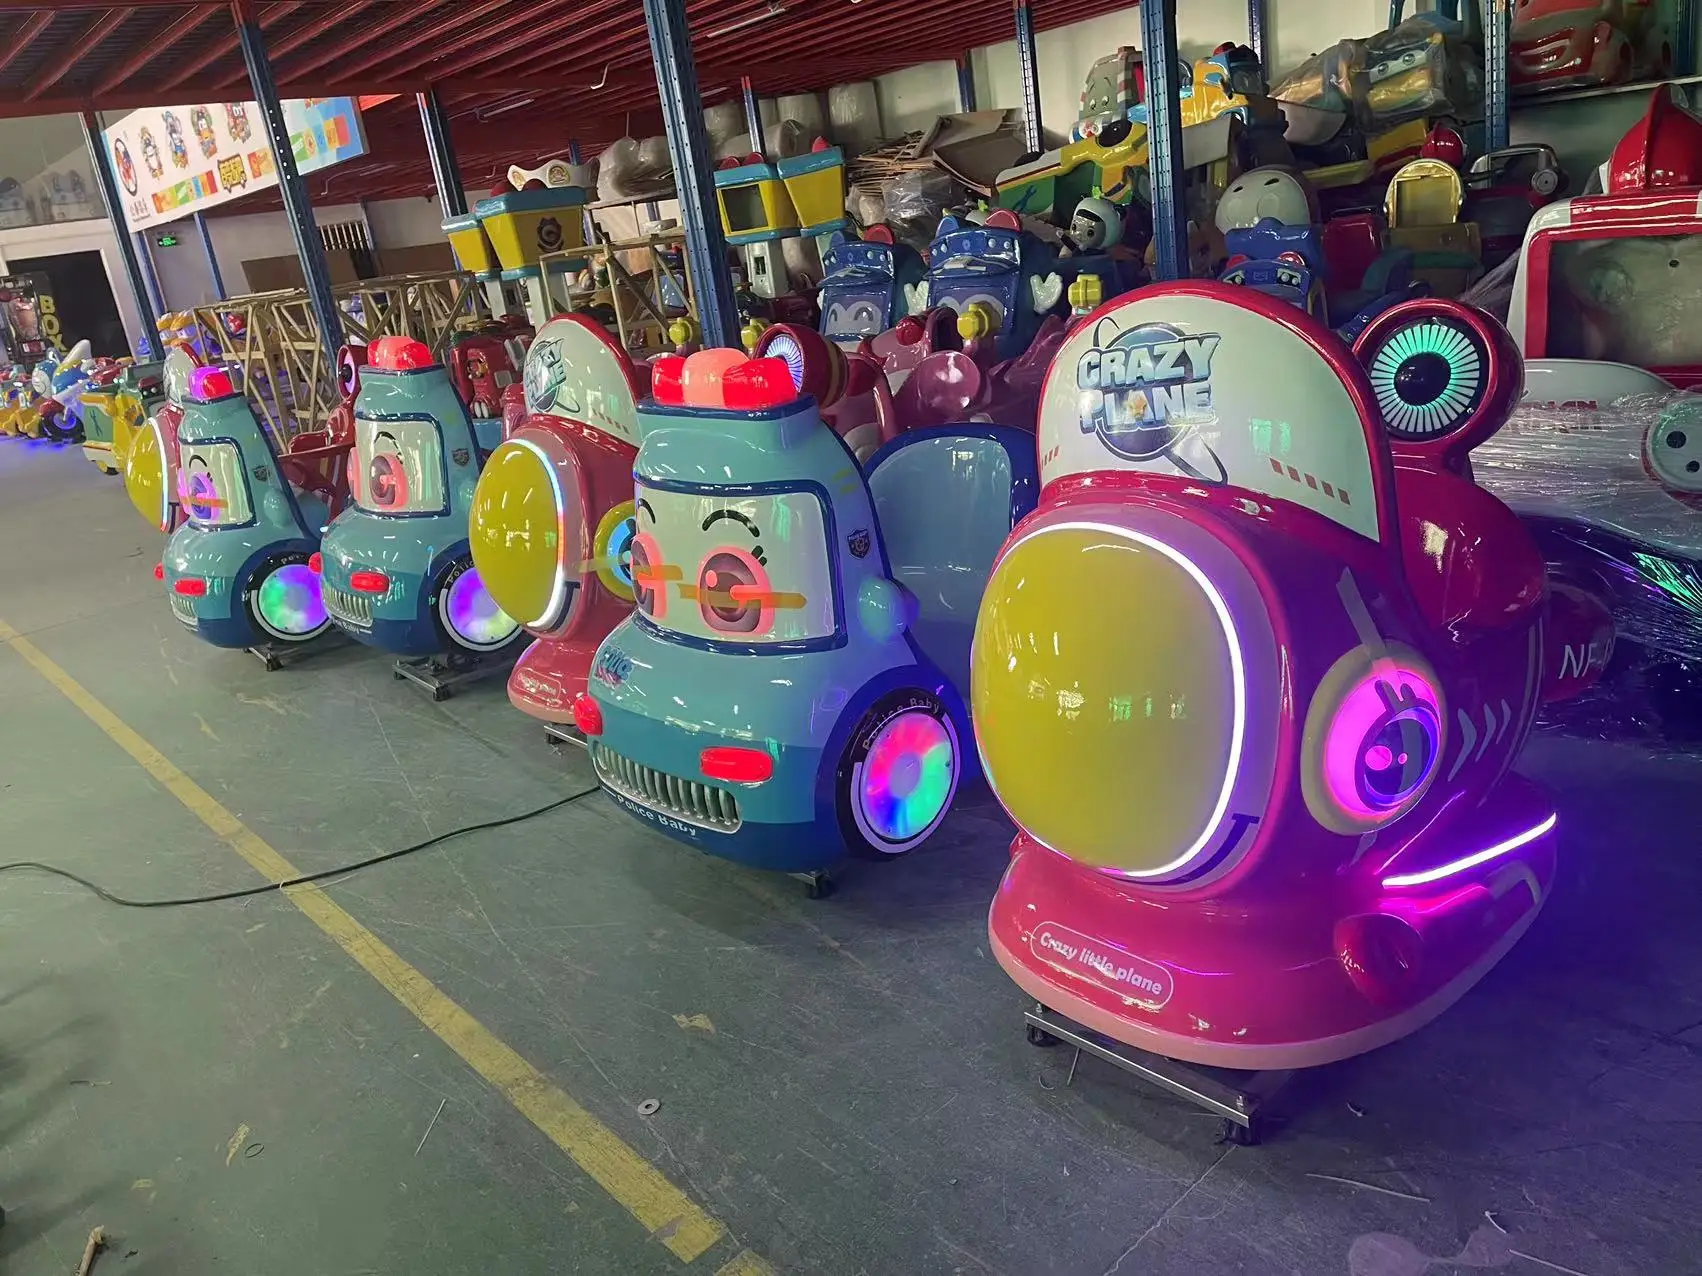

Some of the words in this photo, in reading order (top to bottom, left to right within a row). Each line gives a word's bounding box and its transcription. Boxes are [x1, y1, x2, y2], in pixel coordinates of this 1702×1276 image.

[39, 294, 68, 352] BOX
[1077, 333, 1221, 390] CRAZY
[1079, 382, 1216, 434] PLANE
[910, 697, 940, 714] Baby
[617, 795, 655, 820] Police
[1040, 932, 1078, 961] Crazy
[1078, 947, 1114, 976] little
[1116, 967, 1163, 995] plane
